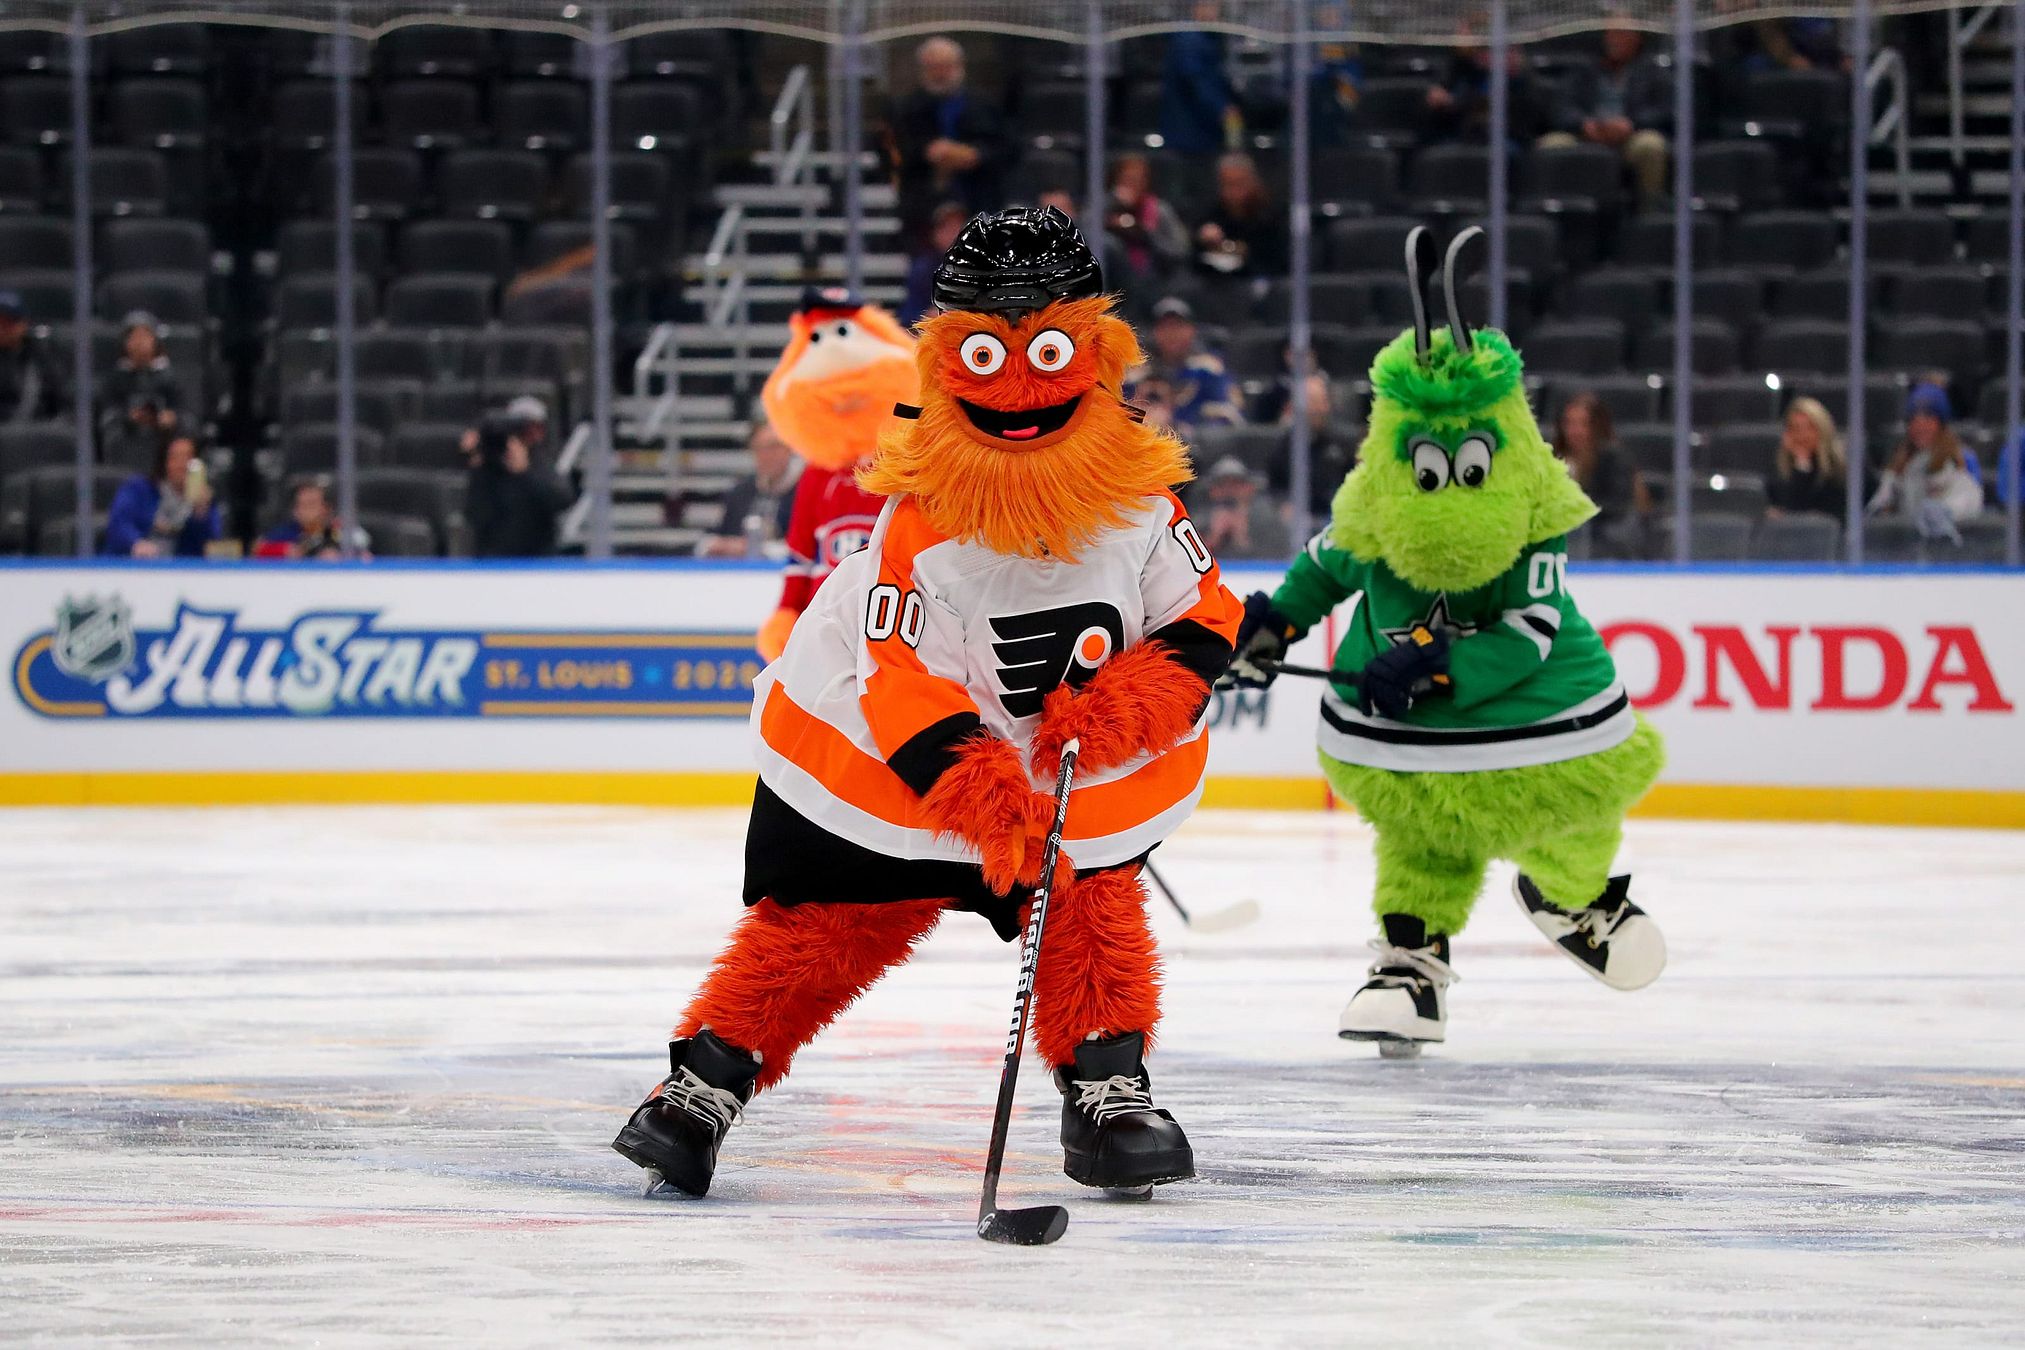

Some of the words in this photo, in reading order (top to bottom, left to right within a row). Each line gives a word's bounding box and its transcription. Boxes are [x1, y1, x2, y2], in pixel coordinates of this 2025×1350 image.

[865, 583, 926, 650] 00
[484, 659, 531, 689] ST.
[537, 659, 632, 690] LOUIS
[673, 659, 757, 690] 2020
[1597, 621, 2015, 713] ONDA
[1058, 765, 1074, 824] WARRIOR
